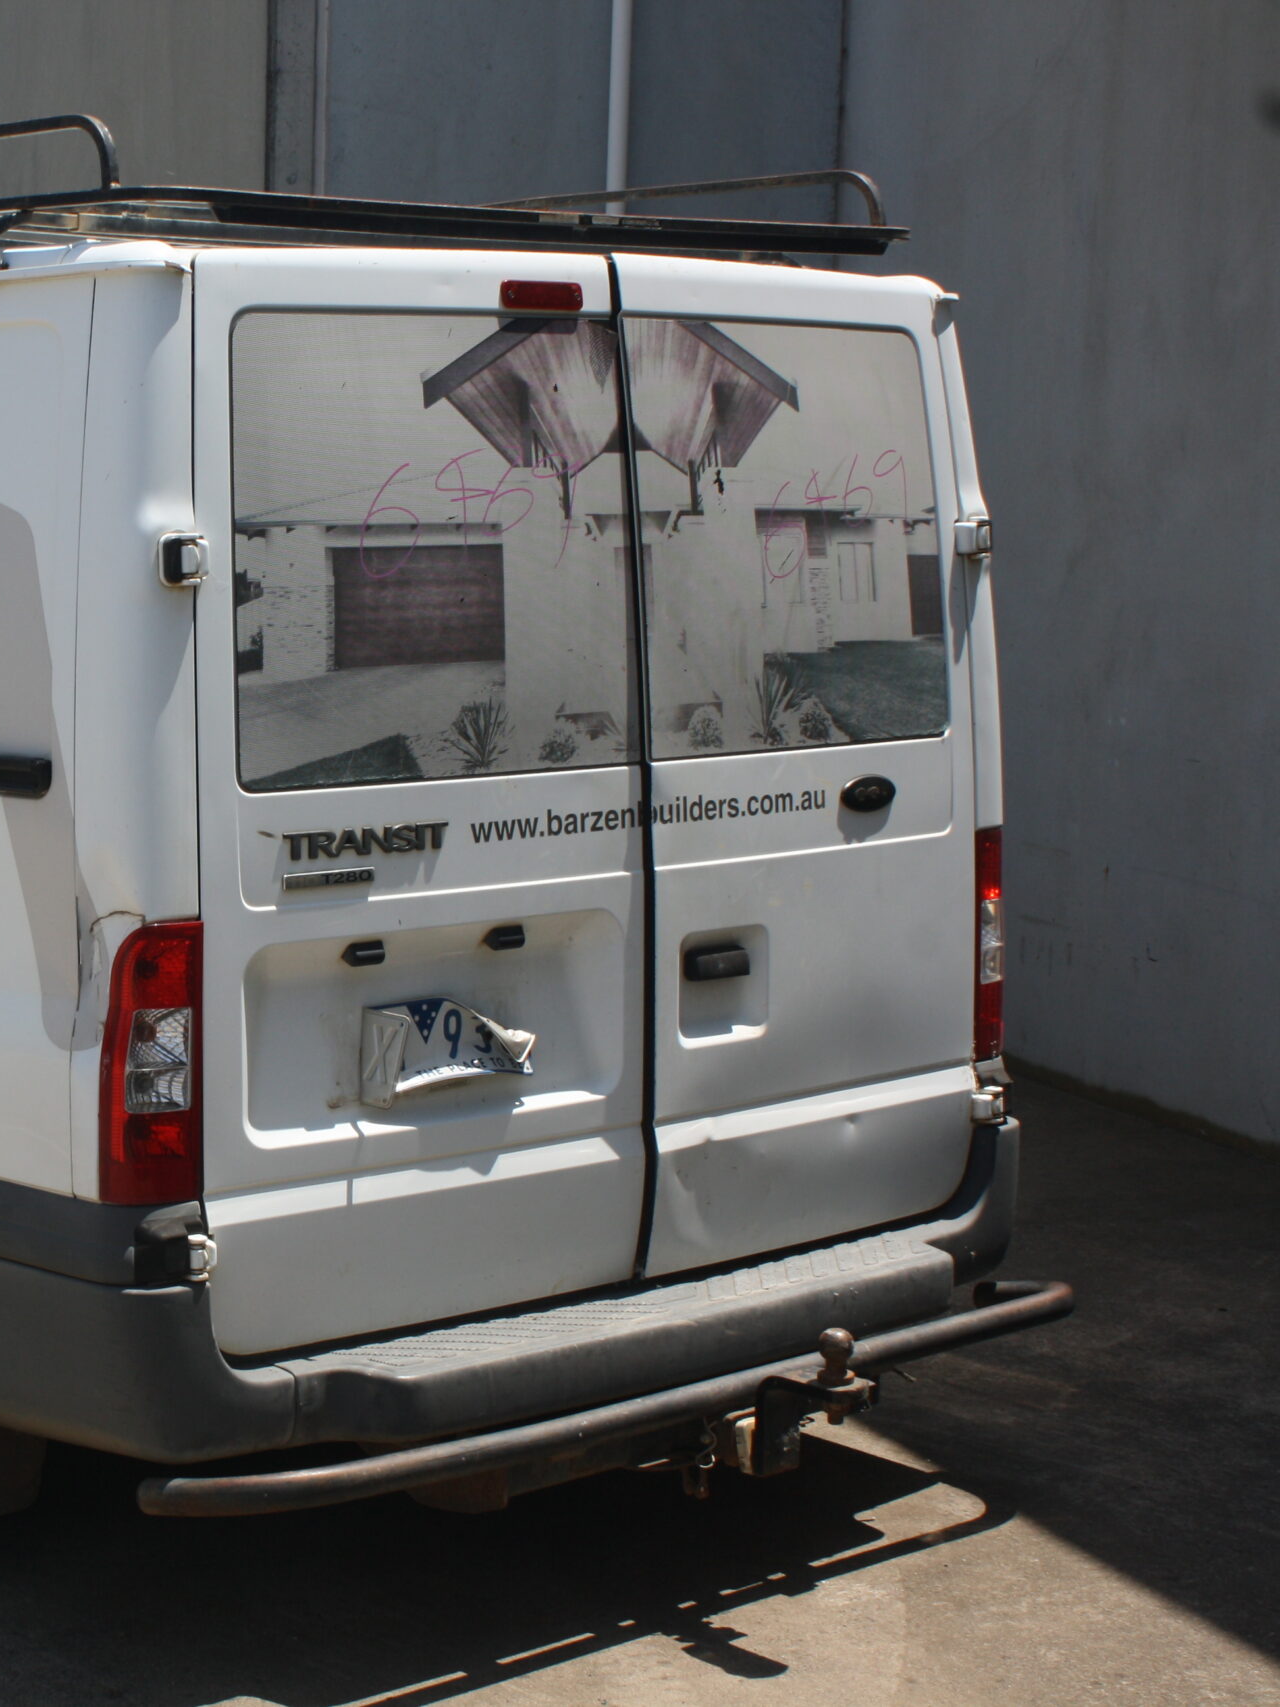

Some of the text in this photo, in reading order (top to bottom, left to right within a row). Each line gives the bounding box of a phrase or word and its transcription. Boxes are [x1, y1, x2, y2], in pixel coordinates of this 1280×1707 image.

[360, 445, 584, 579] 6469
[764, 449, 907, 579] 6469
[282, 821, 449, 861] TRANSIT
[320, 870, 373, 886] T280
[447, 1057, 486, 1073] PLACE
[489, 1057, 505, 1068] TO
